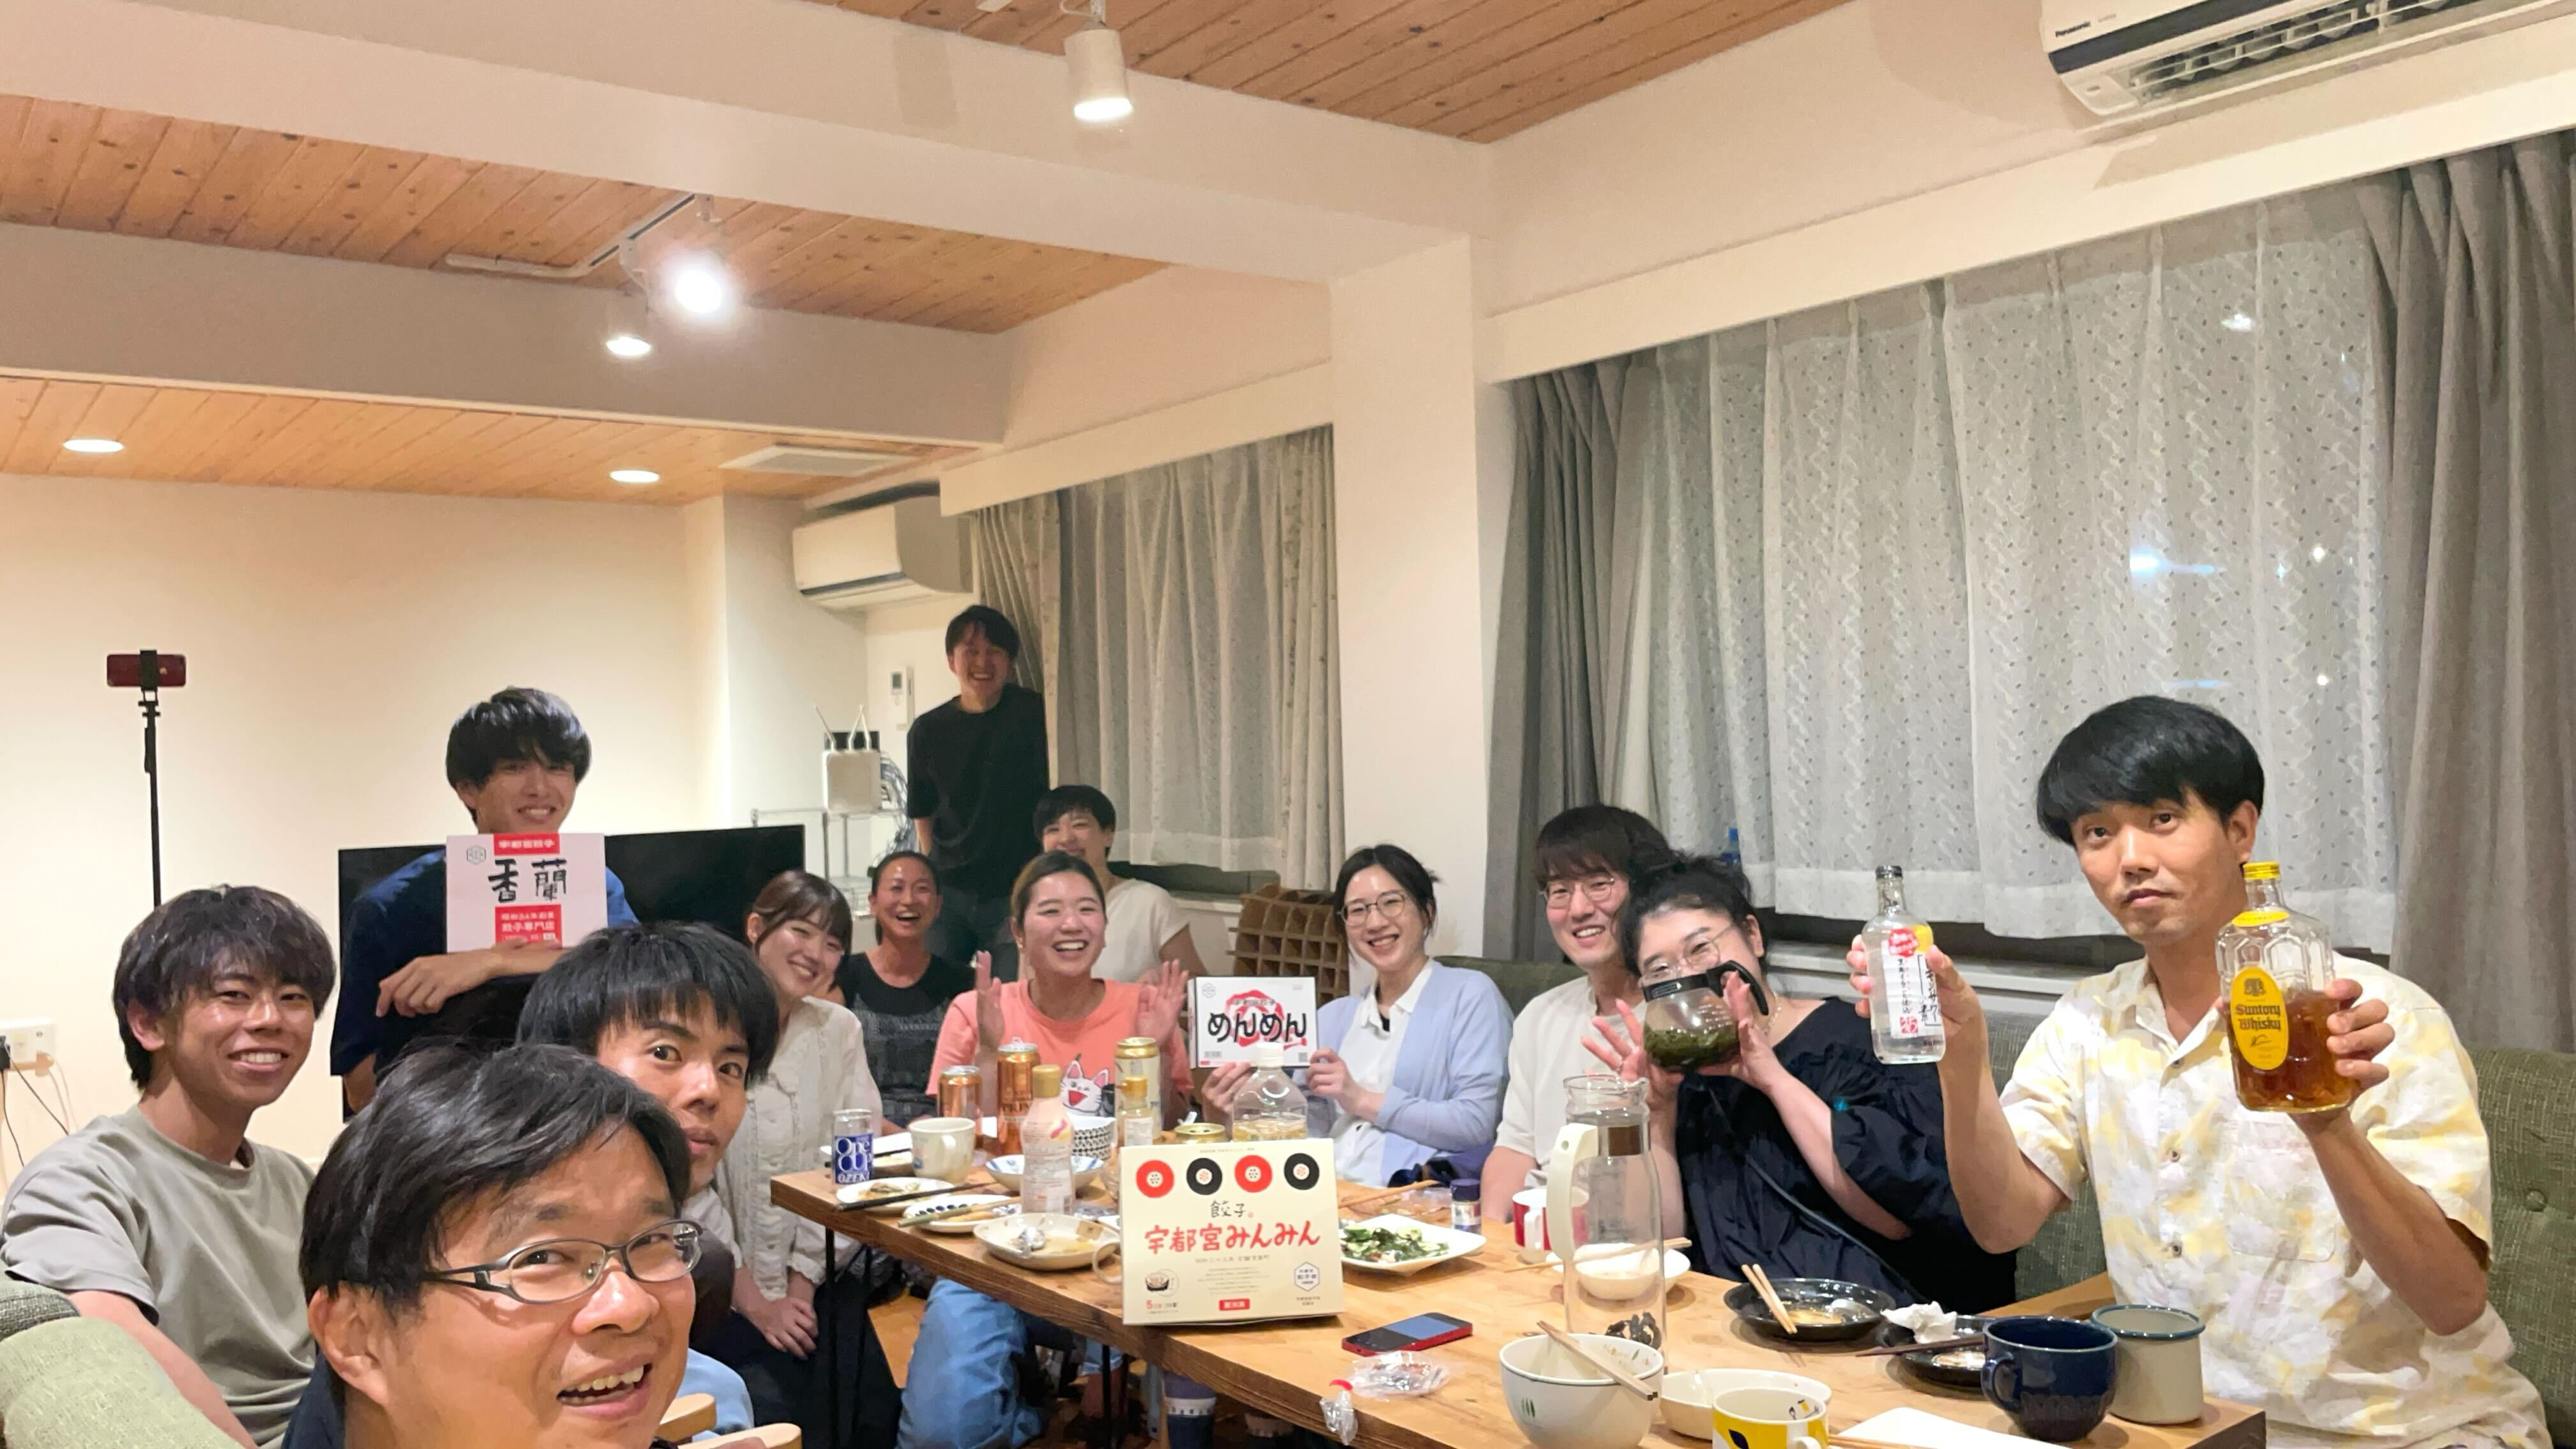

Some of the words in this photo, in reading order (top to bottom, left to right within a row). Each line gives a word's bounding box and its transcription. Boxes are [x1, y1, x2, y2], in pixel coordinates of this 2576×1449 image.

[488, 858, 568, 903] 香蘭
[2235, 1003, 2281, 1018] Suntory
[1207, 1012, 1307, 1043] めんめん
[2238, 1016, 2281, 1032] Whisky
[1210, 1199, 1246, 1218] 餃子
[1144, 1220, 1321, 1254] 宇都宮みんみん
